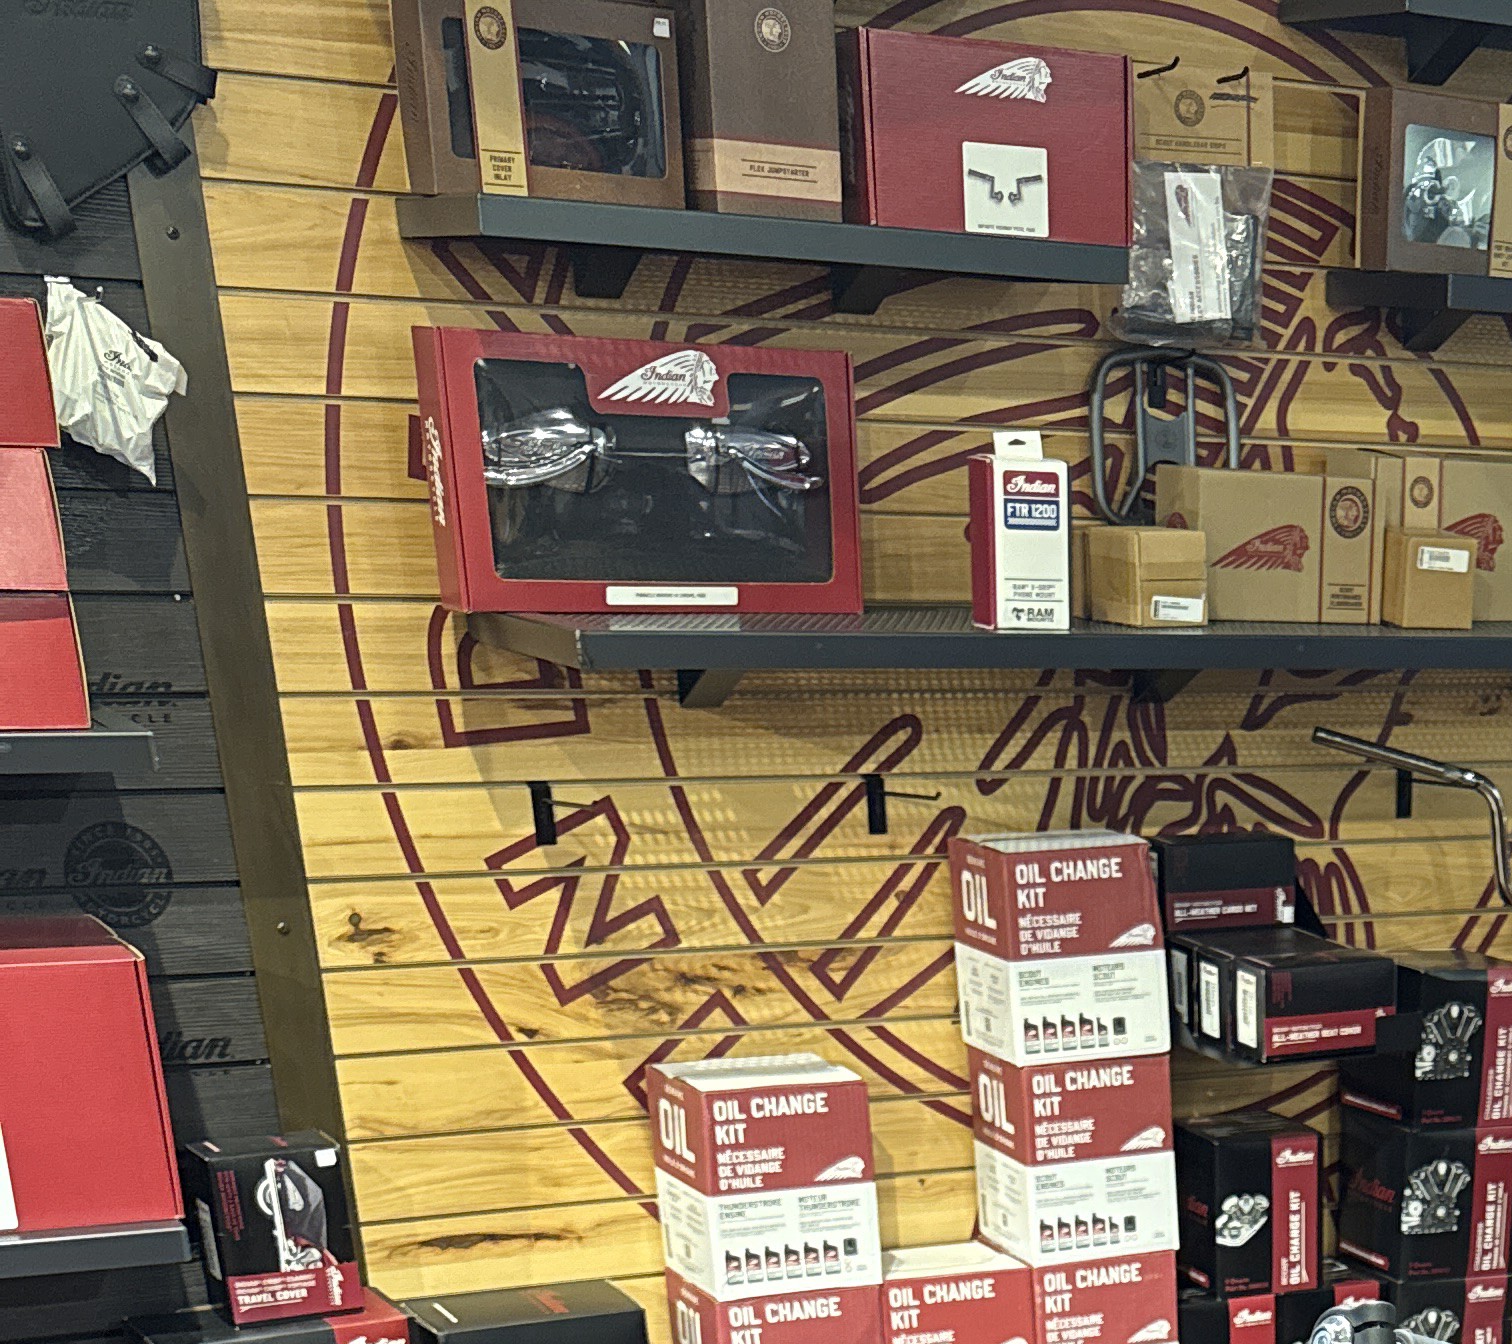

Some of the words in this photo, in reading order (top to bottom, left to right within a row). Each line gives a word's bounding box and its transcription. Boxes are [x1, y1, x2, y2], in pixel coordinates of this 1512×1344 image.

[990, 68, 1027, 82] Indian
[641, 365, 687, 383] Indian
[429, 416, 447, 527] Indian
[1006, 476, 1056, 494] Indian
[1007, 503, 1030, 517] FTR
[1031, 503, 1057, 518] 1200
[1027, 608, 1054, 617] RAM
[1014, 864, 1046, 885] OIL
[1050, 857, 1123, 882] CHANGE
[961, 870, 997, 930] OIL
[1016, 887, 1046, 909] KIT
[1017, 912, 1082, 928] NÉCESSAIRE
[1019, 930, 1034, 942] DE
[1036, 926, 1080, 940] VIDANGE
[1020, 941, 1062, 955] D'HUILE
[1498, 1027, 1508, 1046] KIT
[1032, 1074, 1062, 1095] OIL
[1065, 1065, 1134, 1091] CHANGE
[1494, 1050, 1507, 1098] CHANGE
[713, 1100, 746, 1121] OIL
[750, 1092, 829, 1118] CHANGE
[978, 1073, 1015, 1134] OIL
[1033, 1096, 1062, 1117] KIT
[1491, 1100, 1503, 1120] OIL
[658, 1098, 696, 1163] OIL
[714, 1123, 747, 1145] KIT
[1034, 1117, 1095, 1135] NÉCESSAIRE
[1035, 1136, 1050, 1149] DE
[1051, 1132, 1093, 1147] VIDANGE
[717, 1147, 785, 1164] NÉCESSAIRE
[1036, 1148, 1075, 1161] D'HUILE
[1276, 1148, 1315, 1164] Indian
[719, 1164, 733, 1177] DE
[737, 1161, 782, 1176] VIDANGE
[719, 1175, 764, 1191] D'HUILE
[1486, 1183, 1499, 1201] KIT
[1289, 1190, 1300, 1211] KIT
[1483, 1204, 1495, 1249] CHANGE
[1289, 1212, 1300, 1262] CHANGE
[1481, 1252, 1492, 1270] OIL
[1043, 1273, 1072, 1293] OIL
[1075, 1263, 1142, 1289] CHANGE
[1289, 1263, 1300, 1285] OIL
[237, 1293, 274, 1305] TRAVEL
[276, 1288, 308, 1300] COVER
[889, 1288, 920, 1308] OIL
[923, 1278, 995, 1305] CHANGE
[1467, 1284, 1505, 1300] Indian
[728, 1306, 762, 1327] OIL
[765, 1296, 842, 1324] CHANGE
[1044, 1293, 1073, 1314] KIT
[890, 1309, 920, 1330] KIT
[1045, 1313, 1105, 1331] NÉCESSAIRE
[1233, 1308, 1272, 1324] Indian
[1046, 1331, 1061, 1343] DE
[1062, 1327, 1102, 1340] VIDANGE
